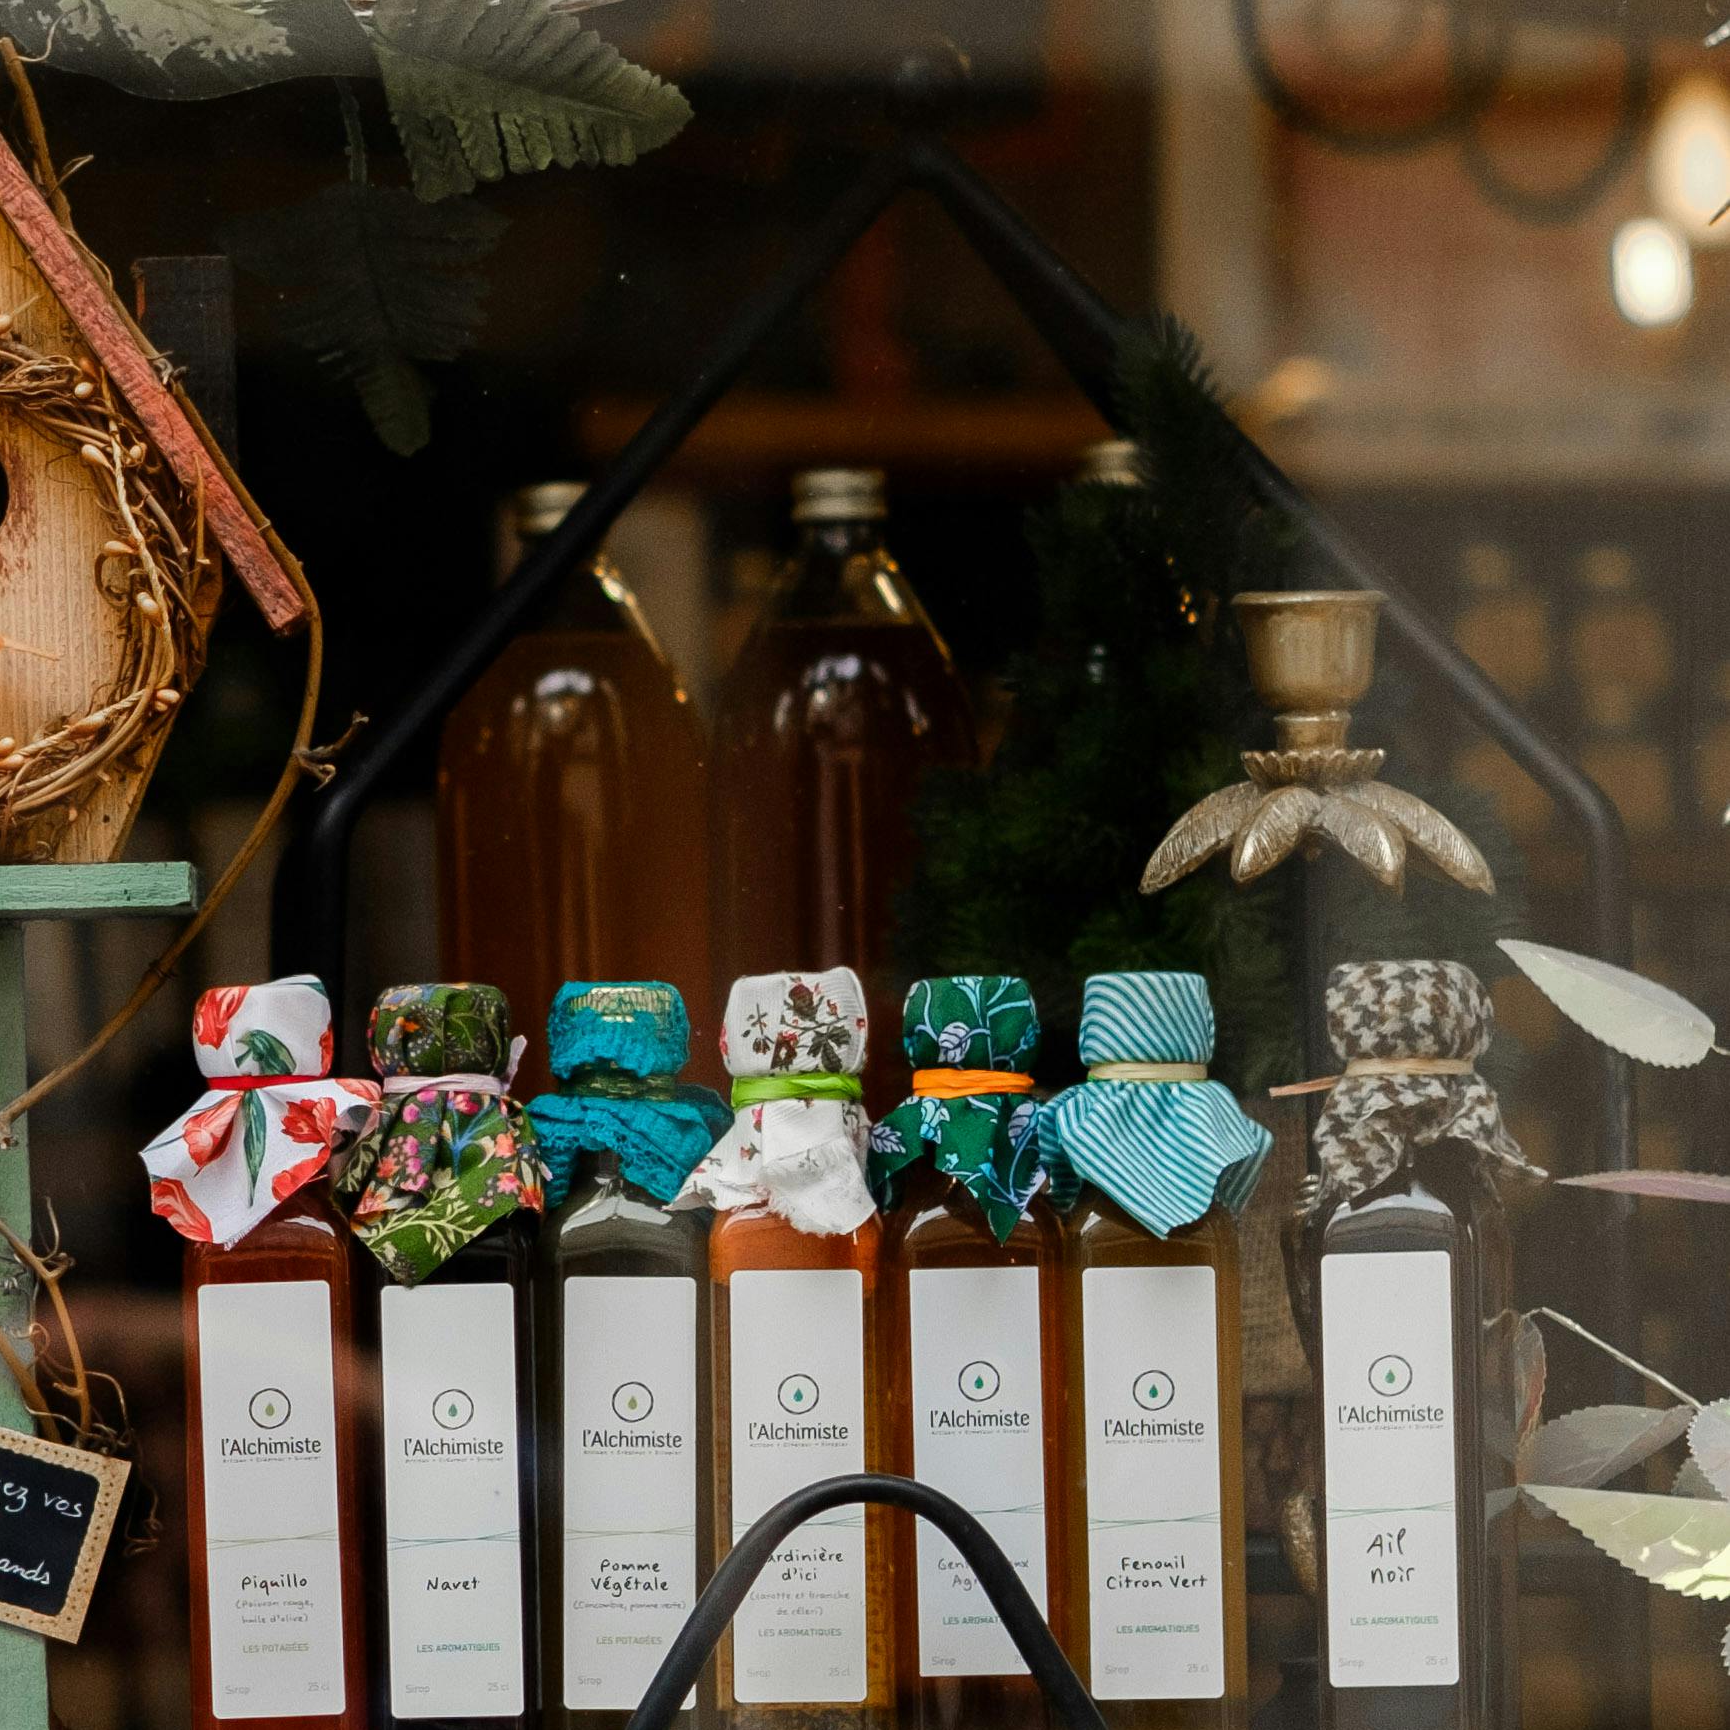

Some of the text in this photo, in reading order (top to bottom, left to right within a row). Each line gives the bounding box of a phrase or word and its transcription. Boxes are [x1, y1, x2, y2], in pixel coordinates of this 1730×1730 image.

[930, 1409, 1031, 1429] l'Alchimiste
[1338, 1404, 1445, 1425] l'Alchimiste
[749, 1422, 849, 1441] l'Alchimiste
[1104, 1419, 1205, 1438] l'Alchimiste
[221, 1437, 322, 1457] l'Alchimiste
[404, 1437, 504, 1457] l'Alchimiste
[582, 1429, 683, 1449] l'Alchimiste
[44, 1491, 84, 1519] vos
[1366, 1527, 1407, 1556] Ail
[767, 1547, 844, 1563] ardinière
[1121, 1555, 1186, 1571] Fenouil
[601, 1558, 661, 1573] Pomme
[241, 1573, 309, 1596] Piquillo
[426, 1576, 479, 1591] Navet
[781, 1569, 818, 1582] d'ici
[1106, 1574, 1208, 1591] Citron Vert
[1370, 1566, 1416, 1585] noir
[591, 1575, 670, 1598] Végétale
[942, 1616, 960, 1626] LES
[1116, 1623, 1200, 1634] LES AROMATIQUES
[1350, 1615, 1439, 1627] LES AROMATIQUES
[758, 1627, 843, 1638] LES AROMATIQUES
[417, 1642, 501, 1654] LES AROMATIQUES
